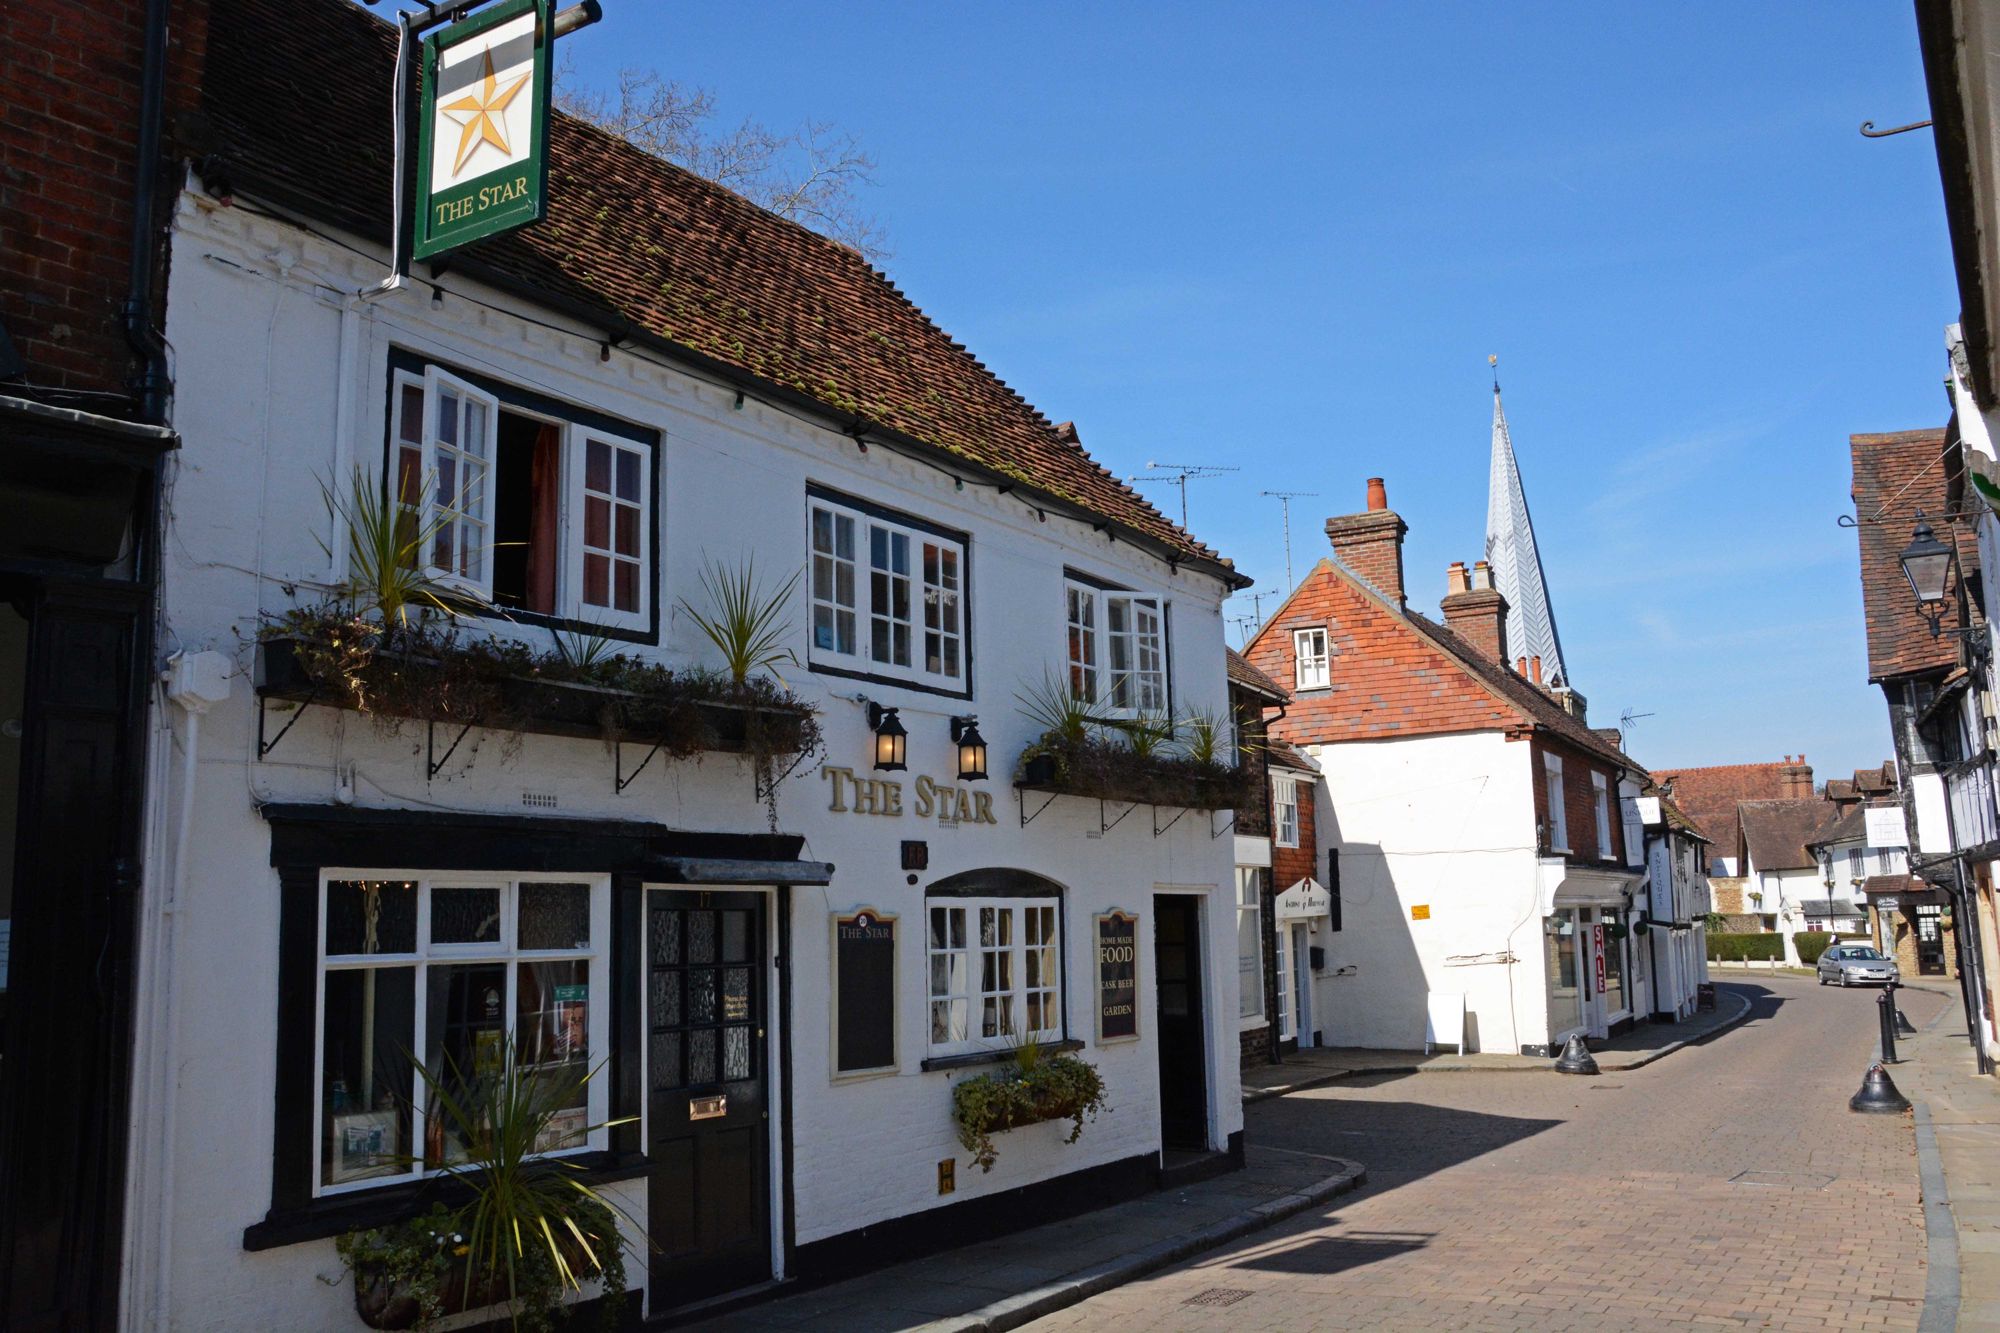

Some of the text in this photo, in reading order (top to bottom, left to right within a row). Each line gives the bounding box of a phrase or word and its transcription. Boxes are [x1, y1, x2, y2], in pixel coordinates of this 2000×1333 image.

[435, 176, 529, 226] THE STAR
[821, 765, 998, 825] THE STAR
[839, 925, 890, 939] THE STAR
[1117, 936, 1133, 945] MADE
[1100, 946, 1134, 964] FOOD
[1595, 926, 1605, 992] SALE
[1118, 979, 1134, 989] BEER
[1103, 1004, 1132, 1017] GARDEN
